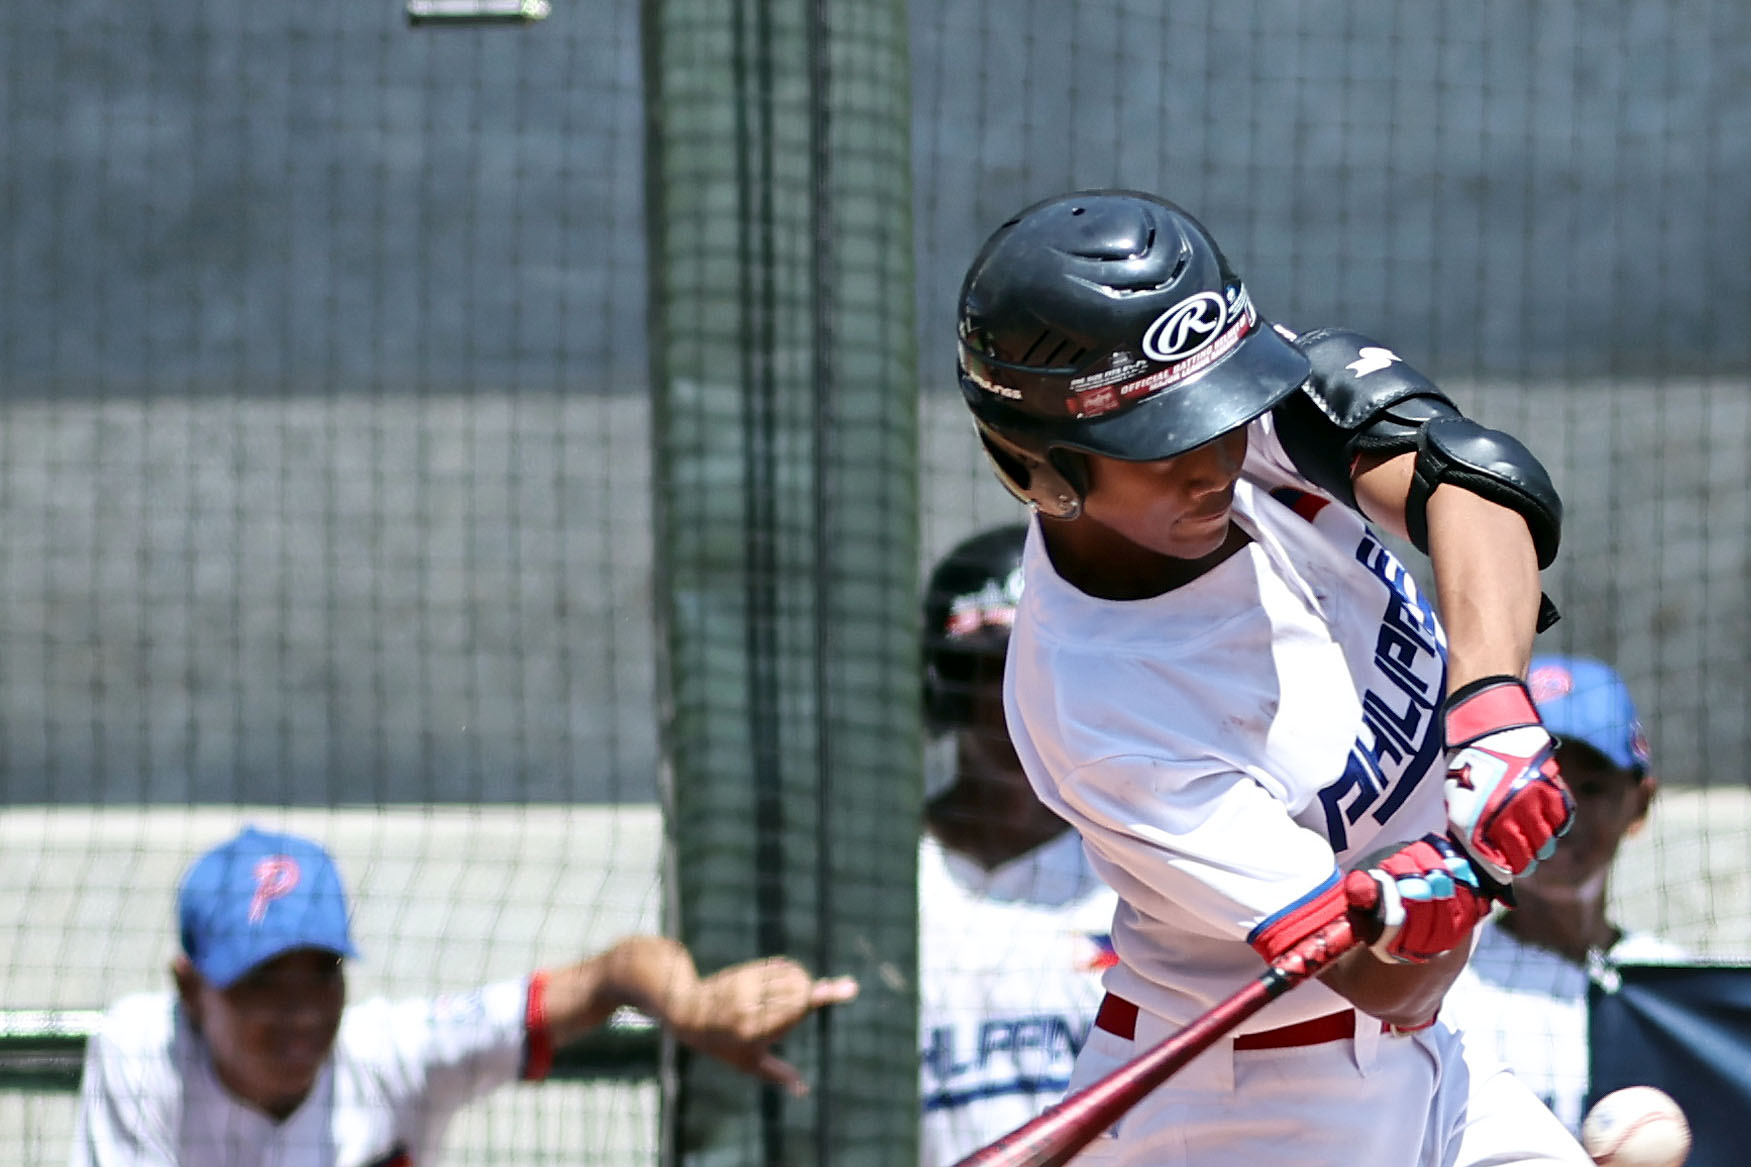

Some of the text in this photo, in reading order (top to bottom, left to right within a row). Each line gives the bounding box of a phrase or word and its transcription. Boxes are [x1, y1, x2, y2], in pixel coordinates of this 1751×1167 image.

[1157, 299, 1218, 354] R
[1120, 368, 1170, 395] OFFICIAL
[1172, 344, 1213, 376] BATTING
[248, 853, 301, 926] P
